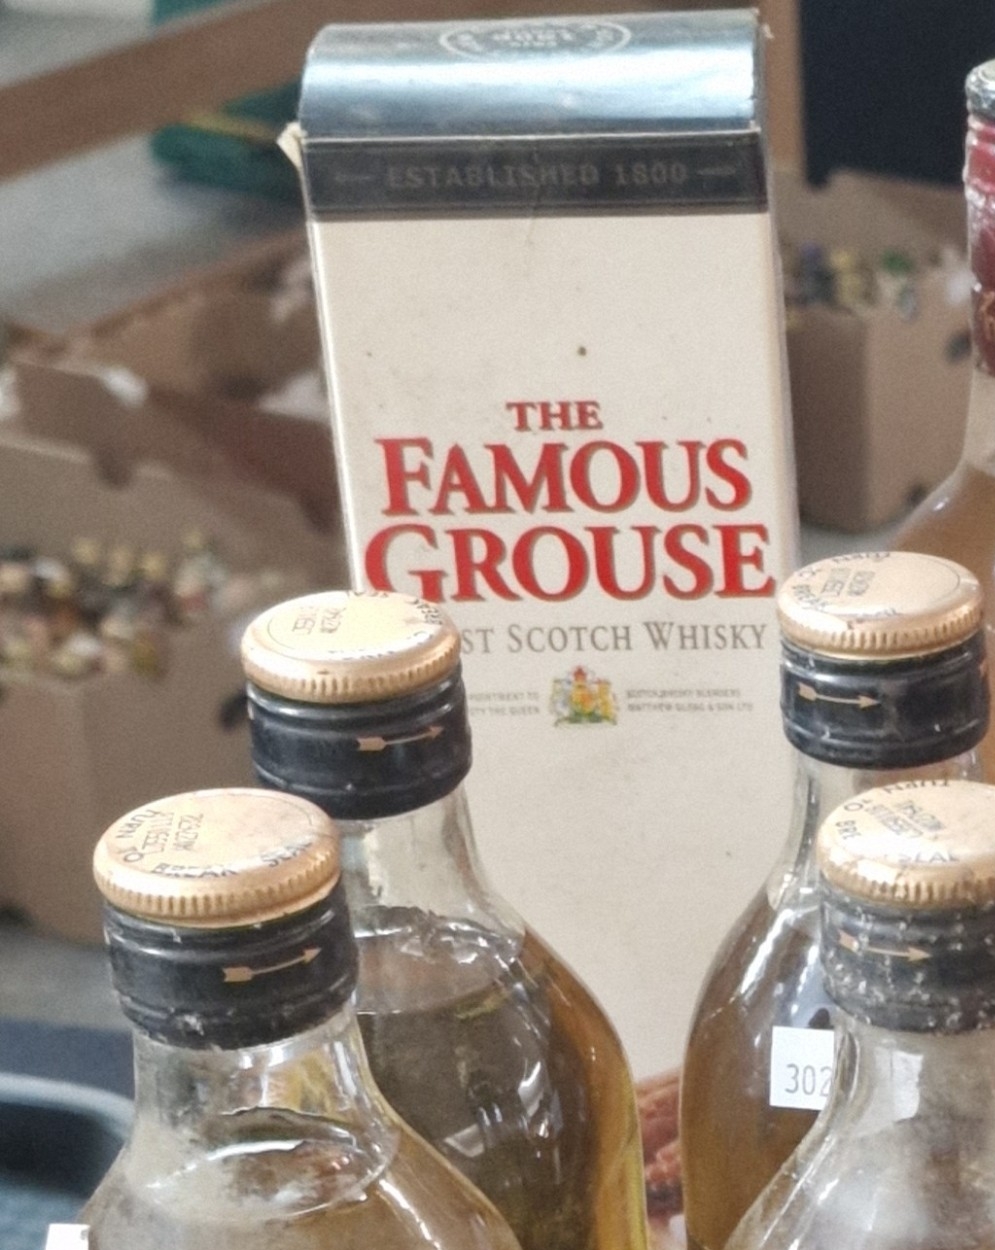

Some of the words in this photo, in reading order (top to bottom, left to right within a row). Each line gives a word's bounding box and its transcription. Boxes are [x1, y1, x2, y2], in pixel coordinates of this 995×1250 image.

[387, 163, 598, 189] ESTABLISHED
[615, 161, 688, 187] 1800
[506, 400, 604, 431] THE
[374, 436, 752, 517] FAMOUS
[364, 523, 777, 603] GROUSE
[462, 627, 496, 654] ST
[507, 623, 633, 654] SCOTCH
[644, 620, 767, 651] WHISKY
[785, 1062, 833, 1098] 302
